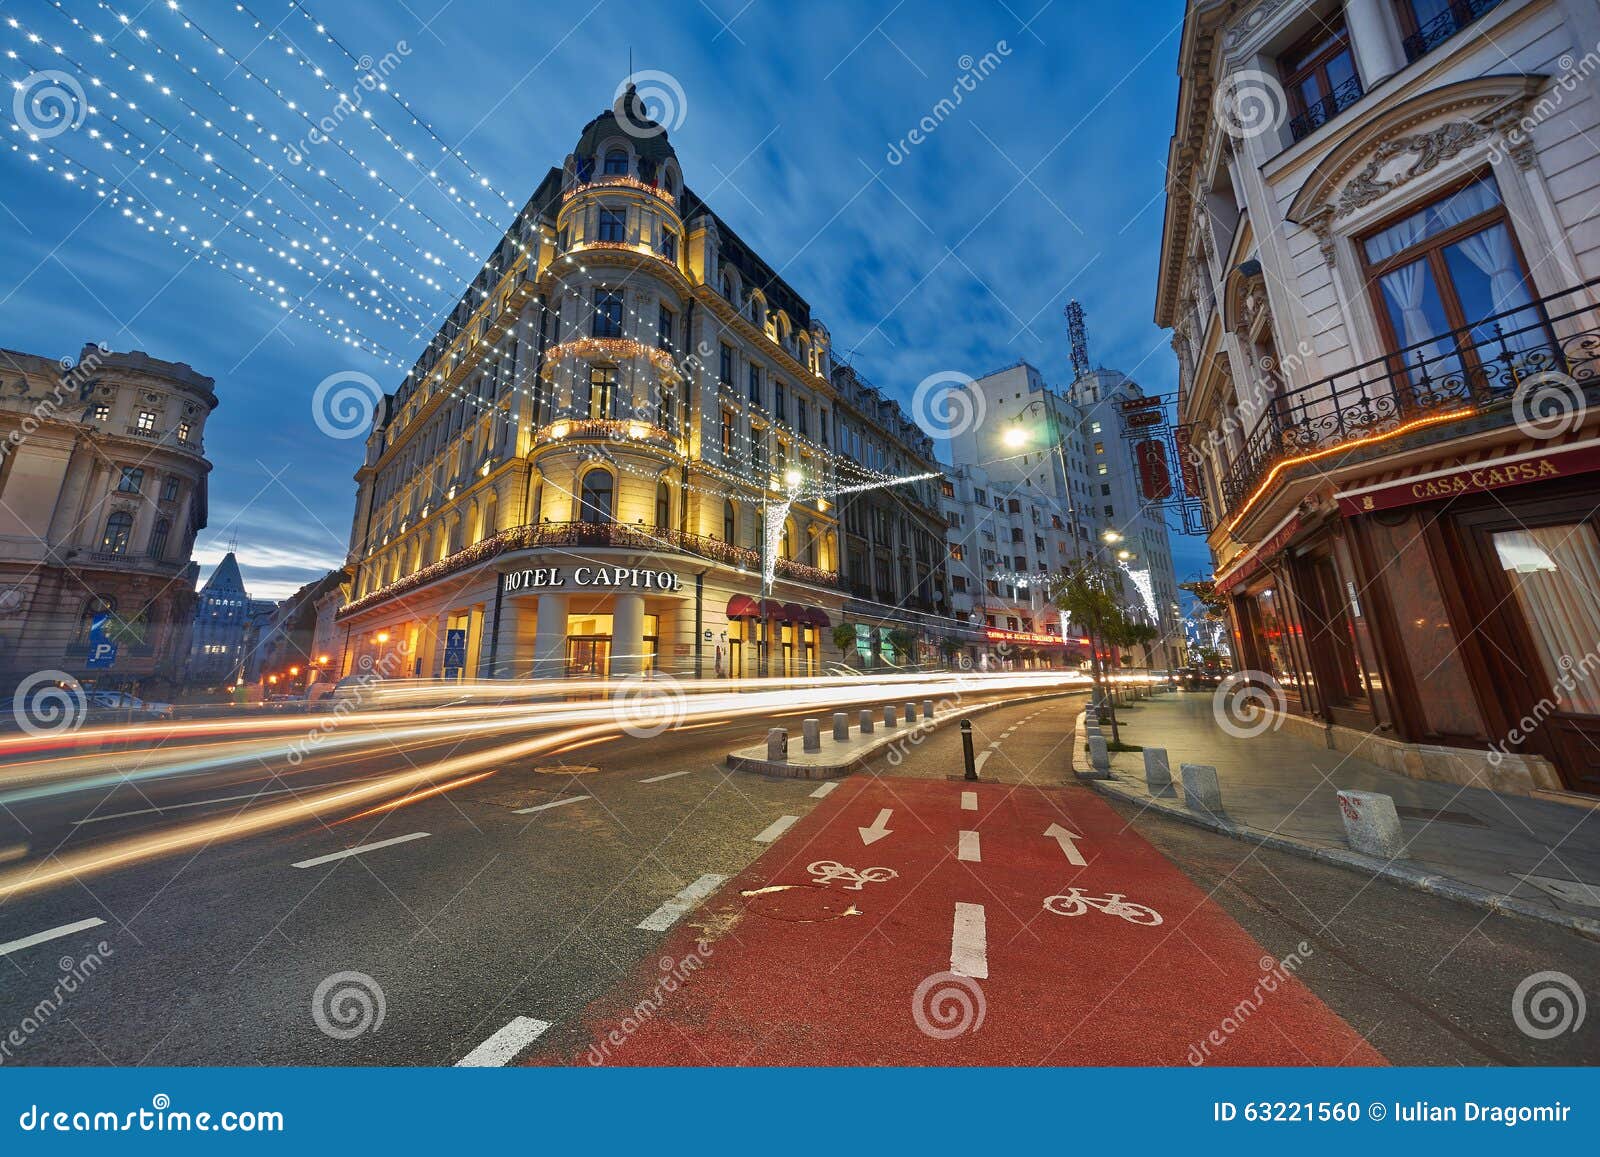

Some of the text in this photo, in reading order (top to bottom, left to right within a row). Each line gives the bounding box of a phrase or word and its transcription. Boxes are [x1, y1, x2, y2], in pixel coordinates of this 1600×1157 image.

[1412, 459, 1560, 498] CASA CAPSA
[505, 567, 682, 591] HOTEL CAPITOL
